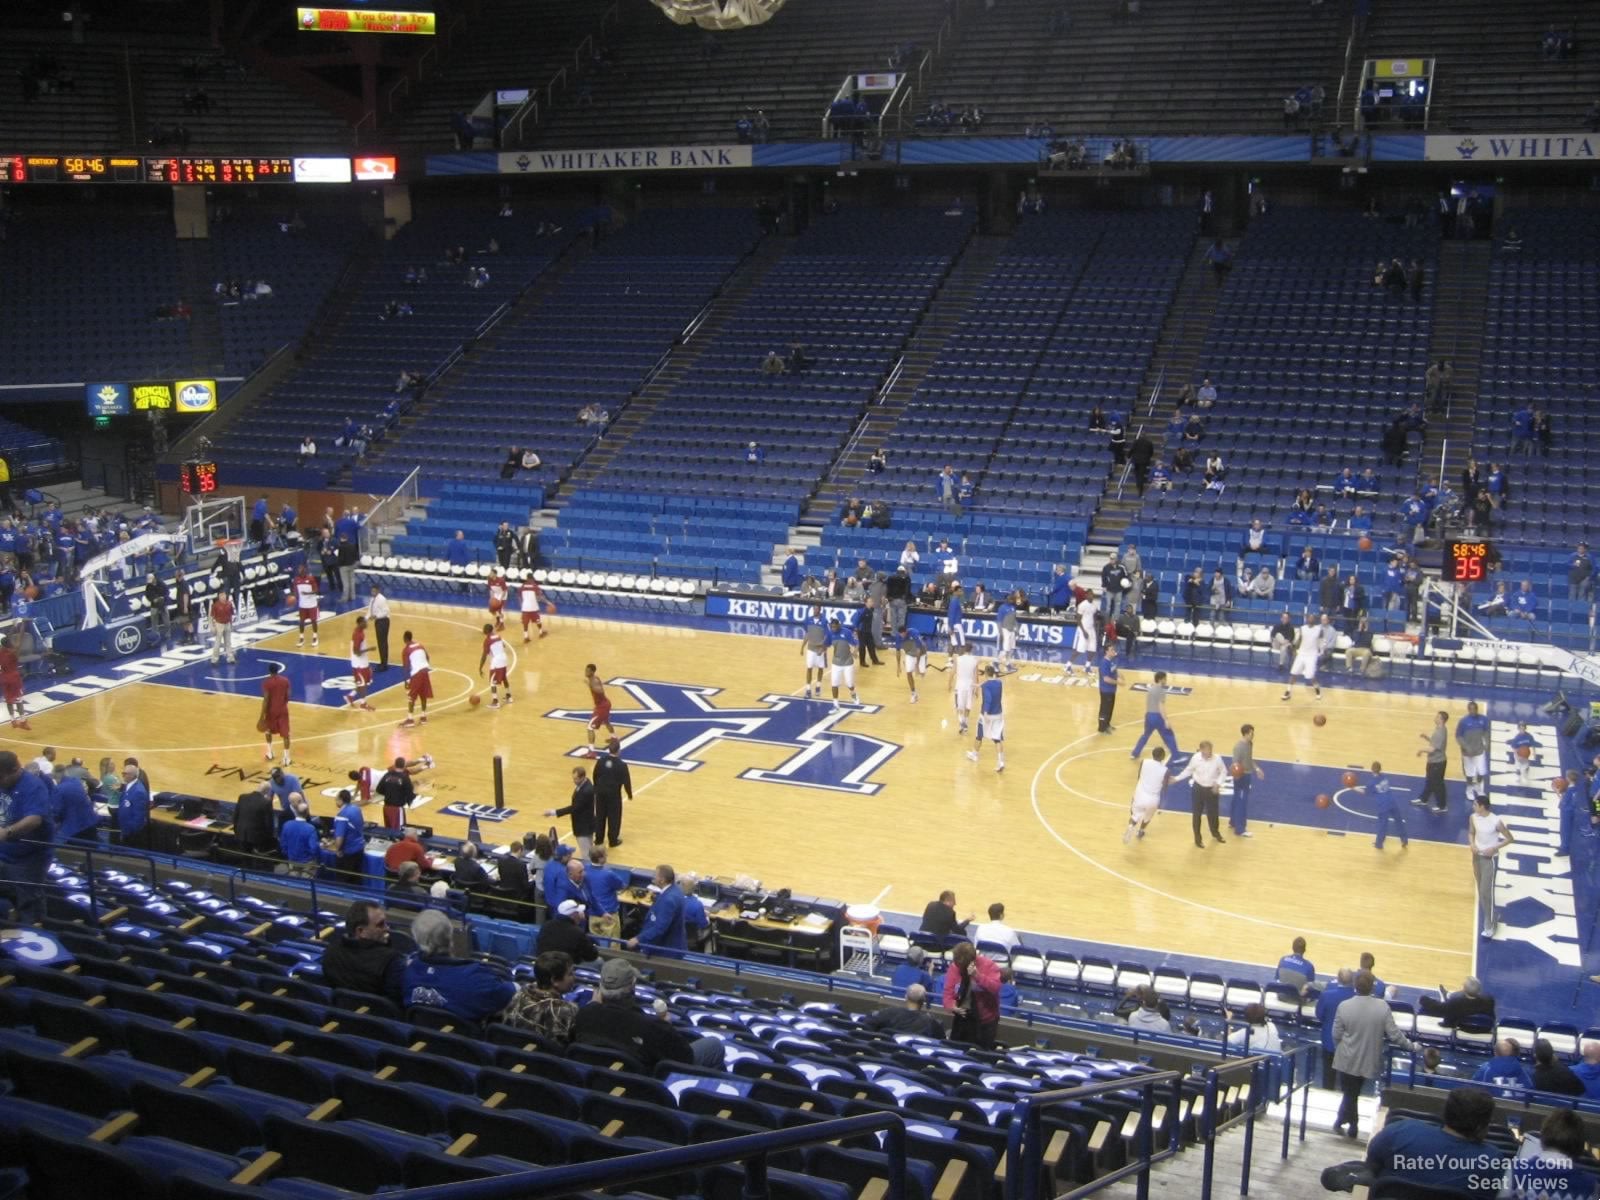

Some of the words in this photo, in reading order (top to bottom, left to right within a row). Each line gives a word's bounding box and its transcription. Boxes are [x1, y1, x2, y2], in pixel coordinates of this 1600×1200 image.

[65, 158, 104, 172] 58:46
[541, 151, 659, 169] WHITAKER
[671, 149, 732, 166] BANK
[200, 473, 215, 492] 35
[1453, 544, 1486, 557] 58:46
[1455, 557, 1480, 579] 35
[1463, 641, 1521, 651] KENTUCKY
[1489, 719, 1582, 967] KENTUCKY
